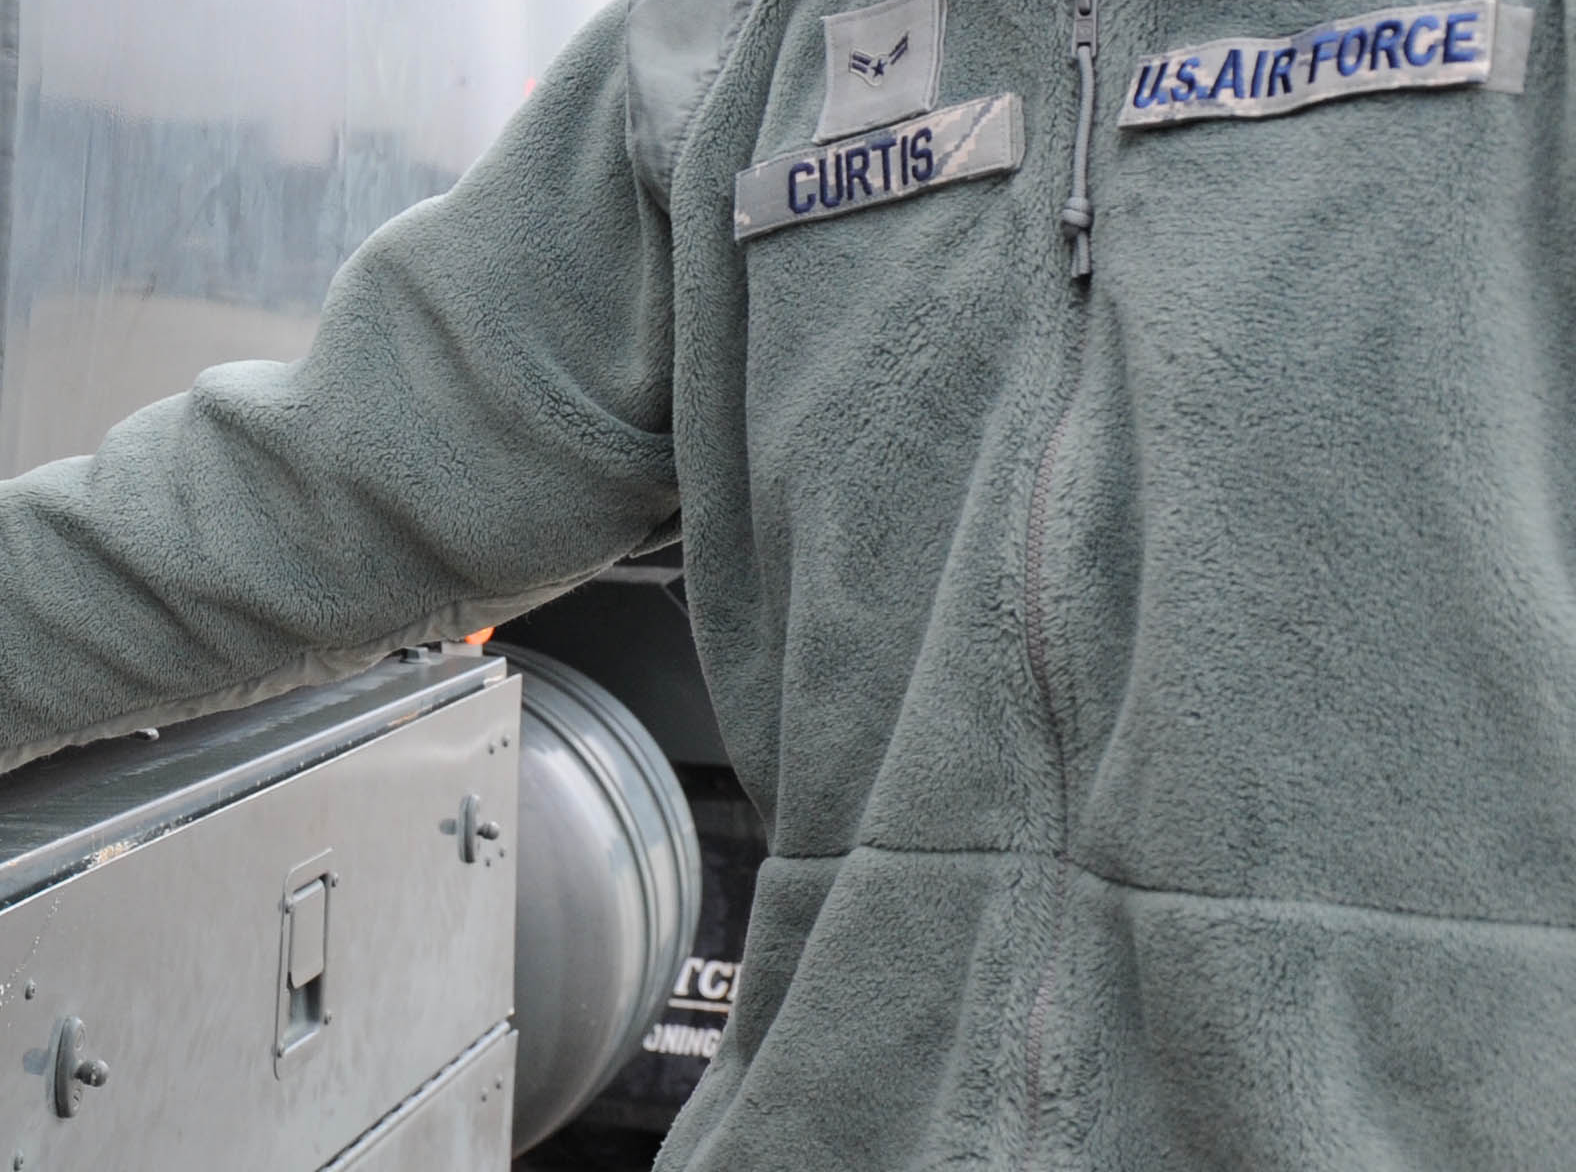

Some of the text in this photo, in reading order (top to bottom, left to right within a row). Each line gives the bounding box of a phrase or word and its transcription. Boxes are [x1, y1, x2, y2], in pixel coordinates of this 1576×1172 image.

[1132, 12, 1480, 111] U.S. AIR FORCE
[788, 127, 935, 215] CURTIS
